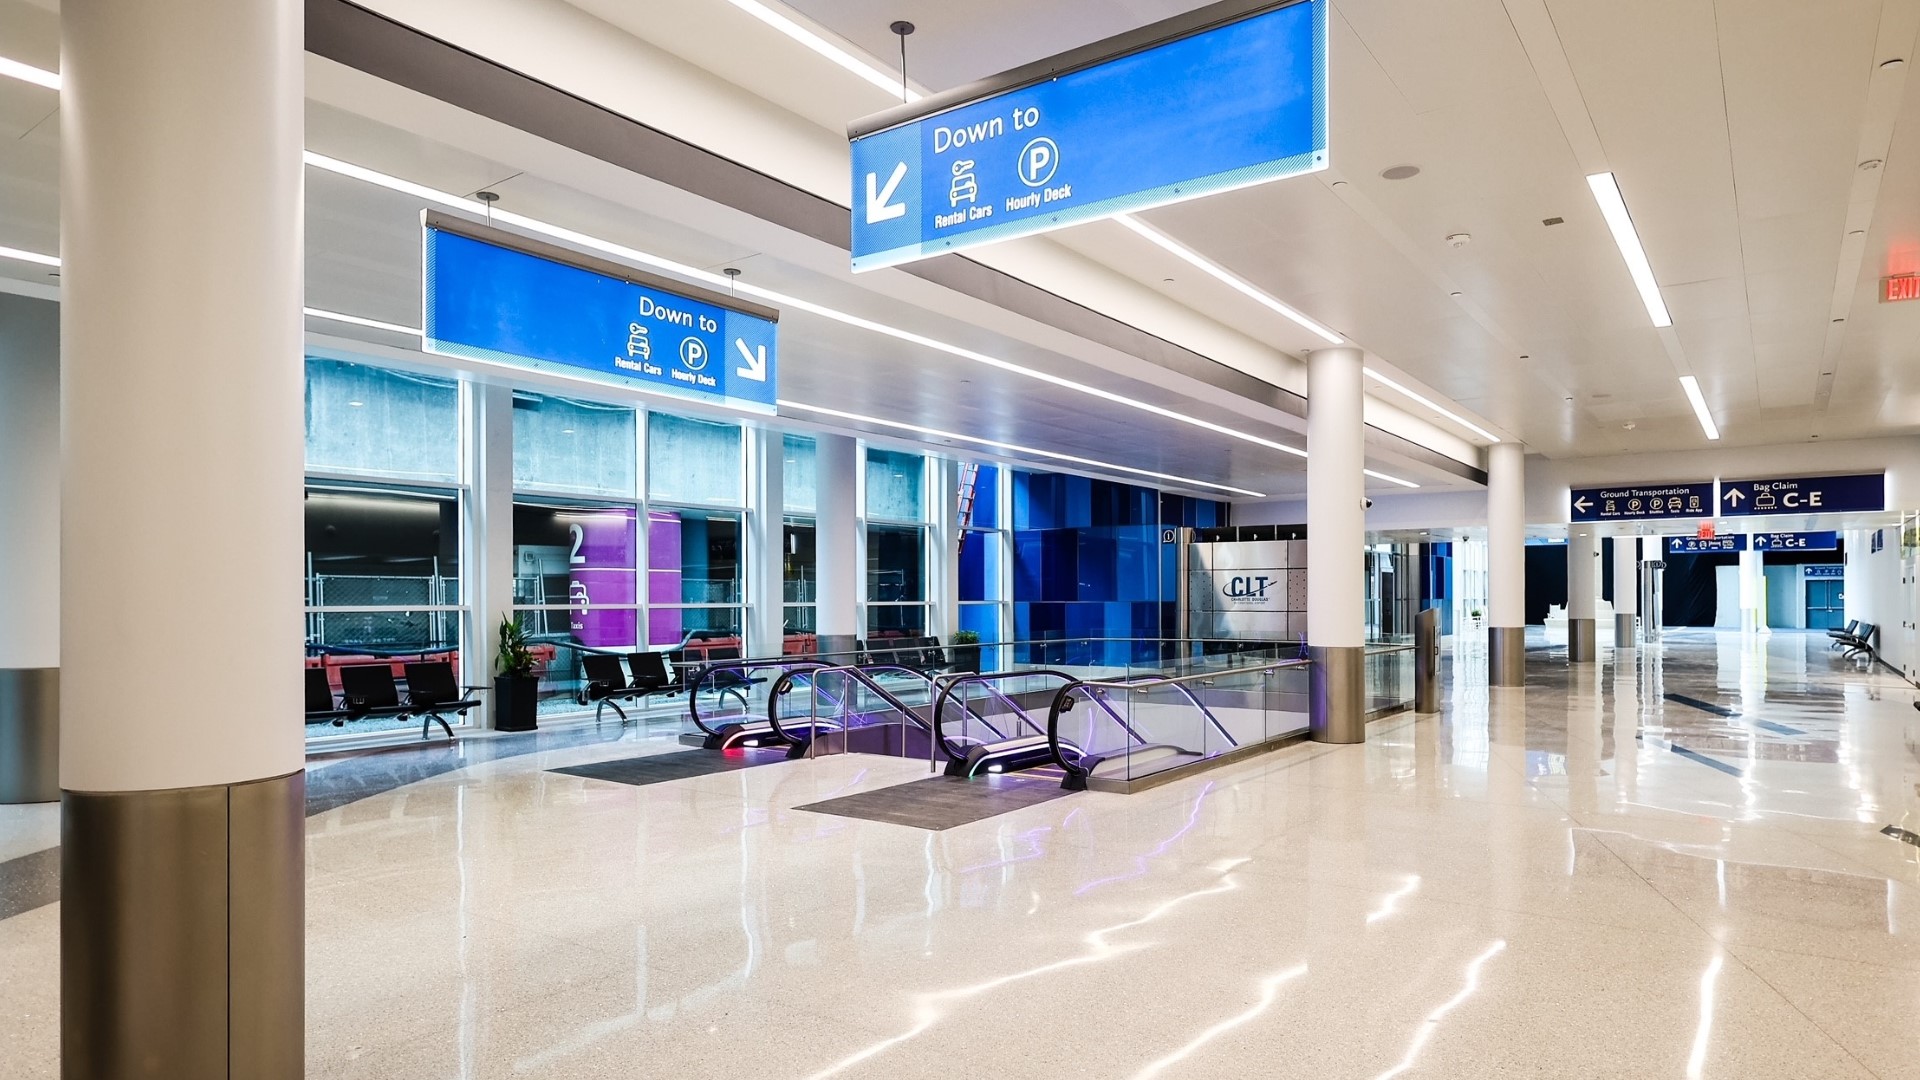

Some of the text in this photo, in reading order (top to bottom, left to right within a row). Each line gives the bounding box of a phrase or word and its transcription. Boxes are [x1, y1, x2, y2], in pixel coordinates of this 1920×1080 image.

[934, 107, 1039, 154] Down to
[1029, 146, 1050, 181] P
[1005, 184, 1072, 212] Hourly Deck
[934, 203, 993, 229] Rental Cars
[1887, 278, 1920, 300] EXIT
[639, 296, 717, 333] Down to
[688, 342, 702, 365] P
[615, 356, 663, 376] Rental Cars
[671, 368, 716, 387] Hourly Deck
[1600, 487, 1690, 499] Ground Transportation
[1753, 481, 1798, 493] Bag Claim
[1631, 501, 1638, 509] P
[1653, 500, 1660, 508] P
[1783, 491, 1822, 507] C-E
[569, 523, 586, 564] 2
[1785, 538, 1806, 547] C-E
[1231, 576, 1268, 597] CLT
